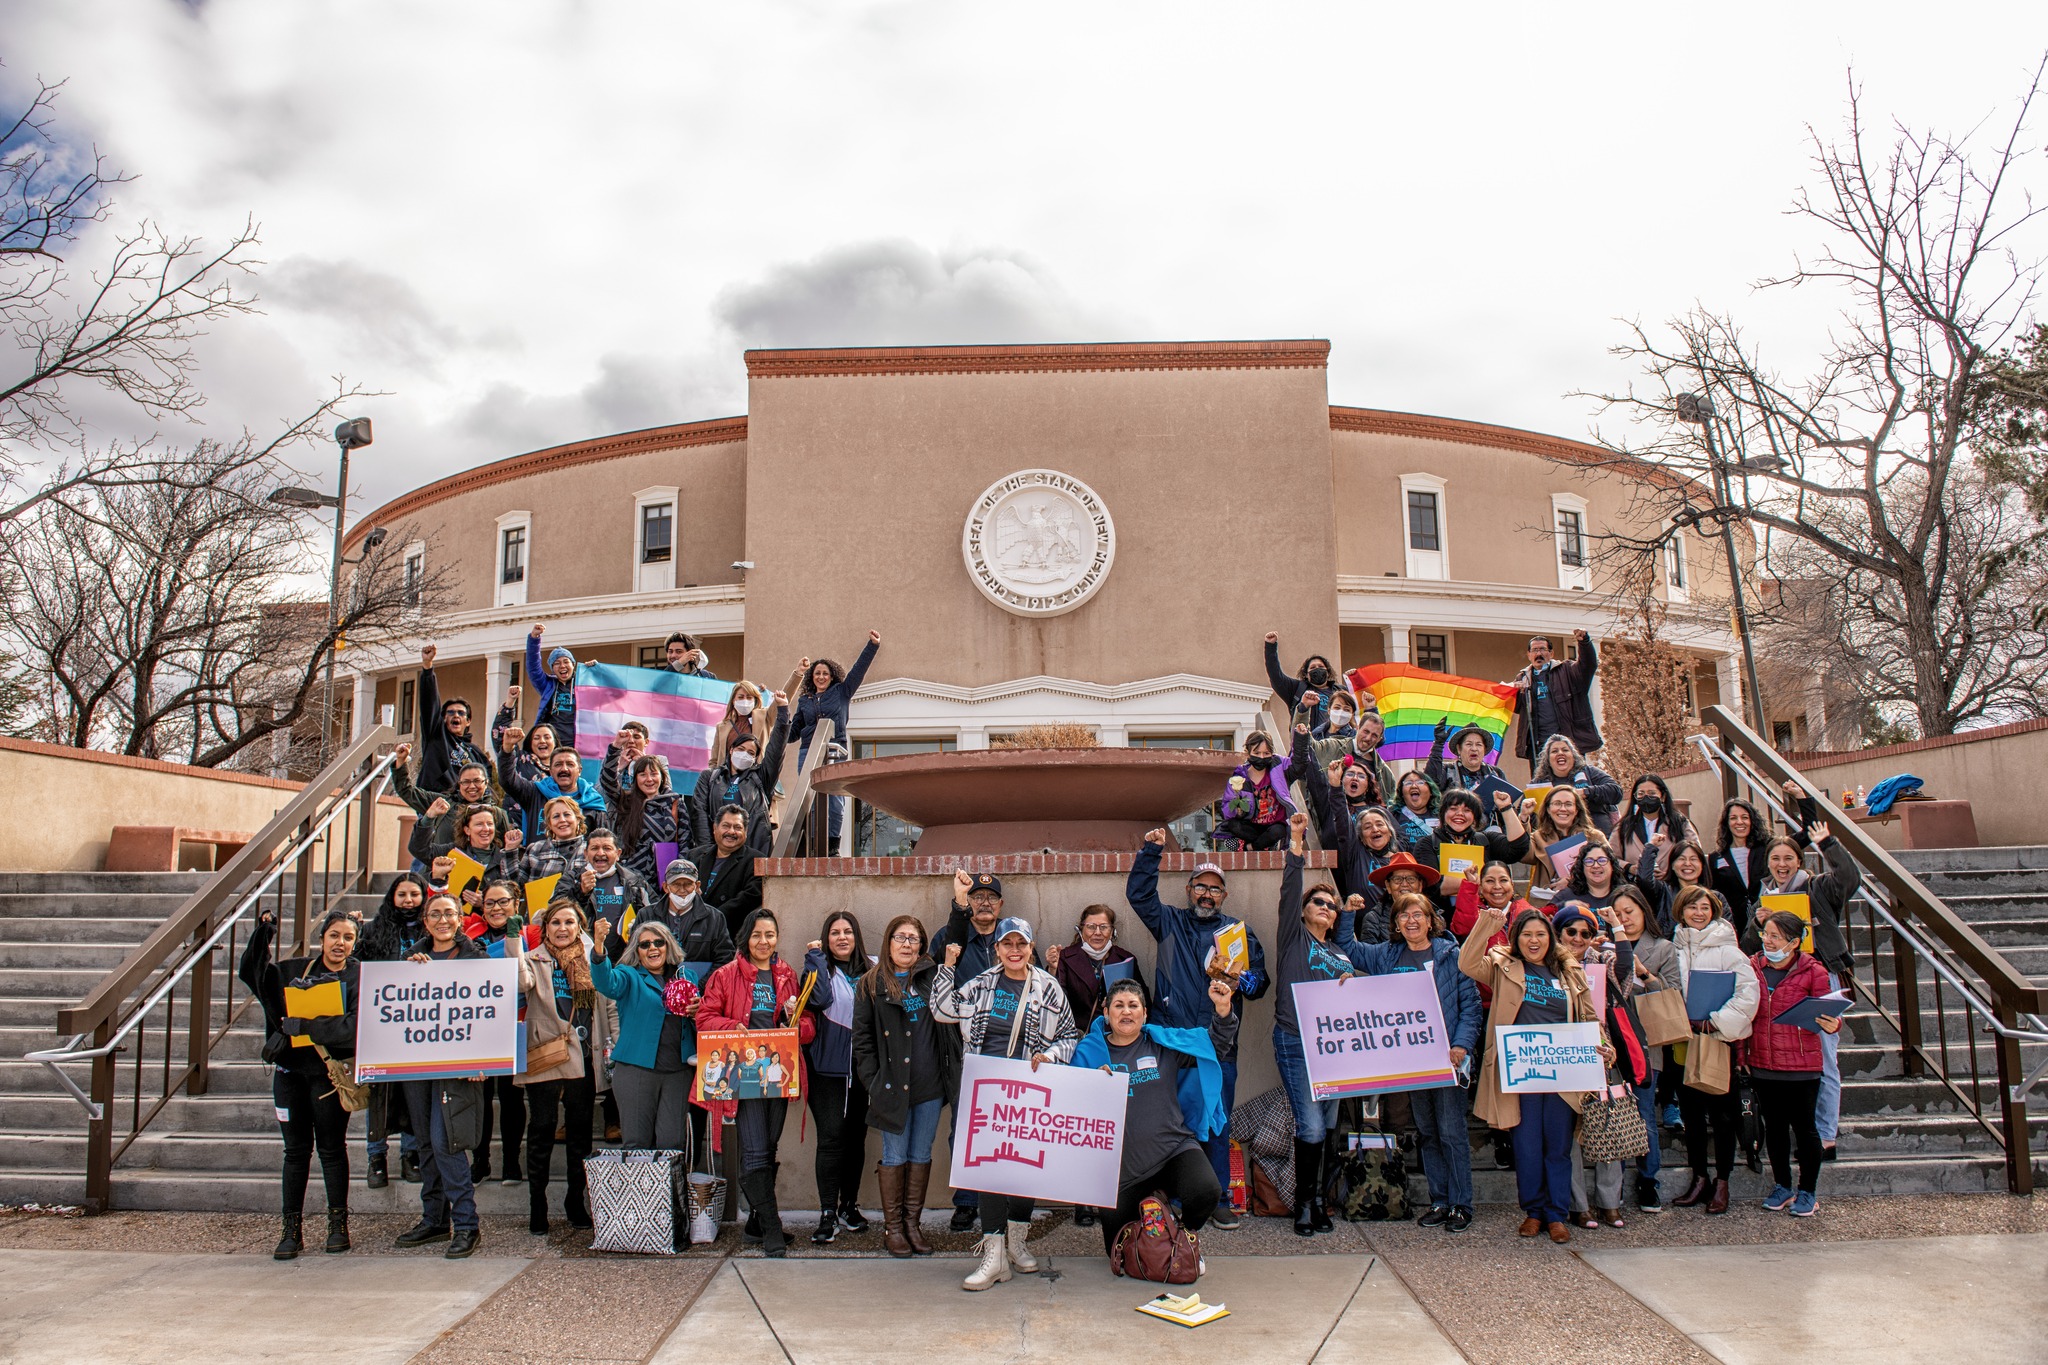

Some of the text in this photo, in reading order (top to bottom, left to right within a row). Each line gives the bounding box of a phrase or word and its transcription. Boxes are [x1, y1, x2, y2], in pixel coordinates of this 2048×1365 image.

[1000, 475, 1028, 495] THE
[1034, 473, 1080, 494] STATE
[982, 492, 999, 510] OF
[1081, 492, 1099, 512] OF
[970, 518, 984, 552] SEAL
[1094, 515, 1109, 544] NEW
[974, 558, 1008, 598] GREAT
[1072, 550, 1108, 598] MEXICO
[1025, 597, 1057, 608] 1912
[373, 980, 504, 1006] ¡Cuidado de
[380, 1003, 496, 1025] Salud para
[1316, 1010, 1427, 1033] Healthcare
[404, 1023, 472, 1043] todos!
[1316, 1026, 1435, 1055] for all of us!
[1519, 1045, 1597, 1057] NM TOGETHER
[1530, 1055, 1598, 1065] HEALTHCARE
[992, 1103, 1116, 1135] NM TOGETHER
[991, 1122, 1114, 1151] for HEALTHCARE
